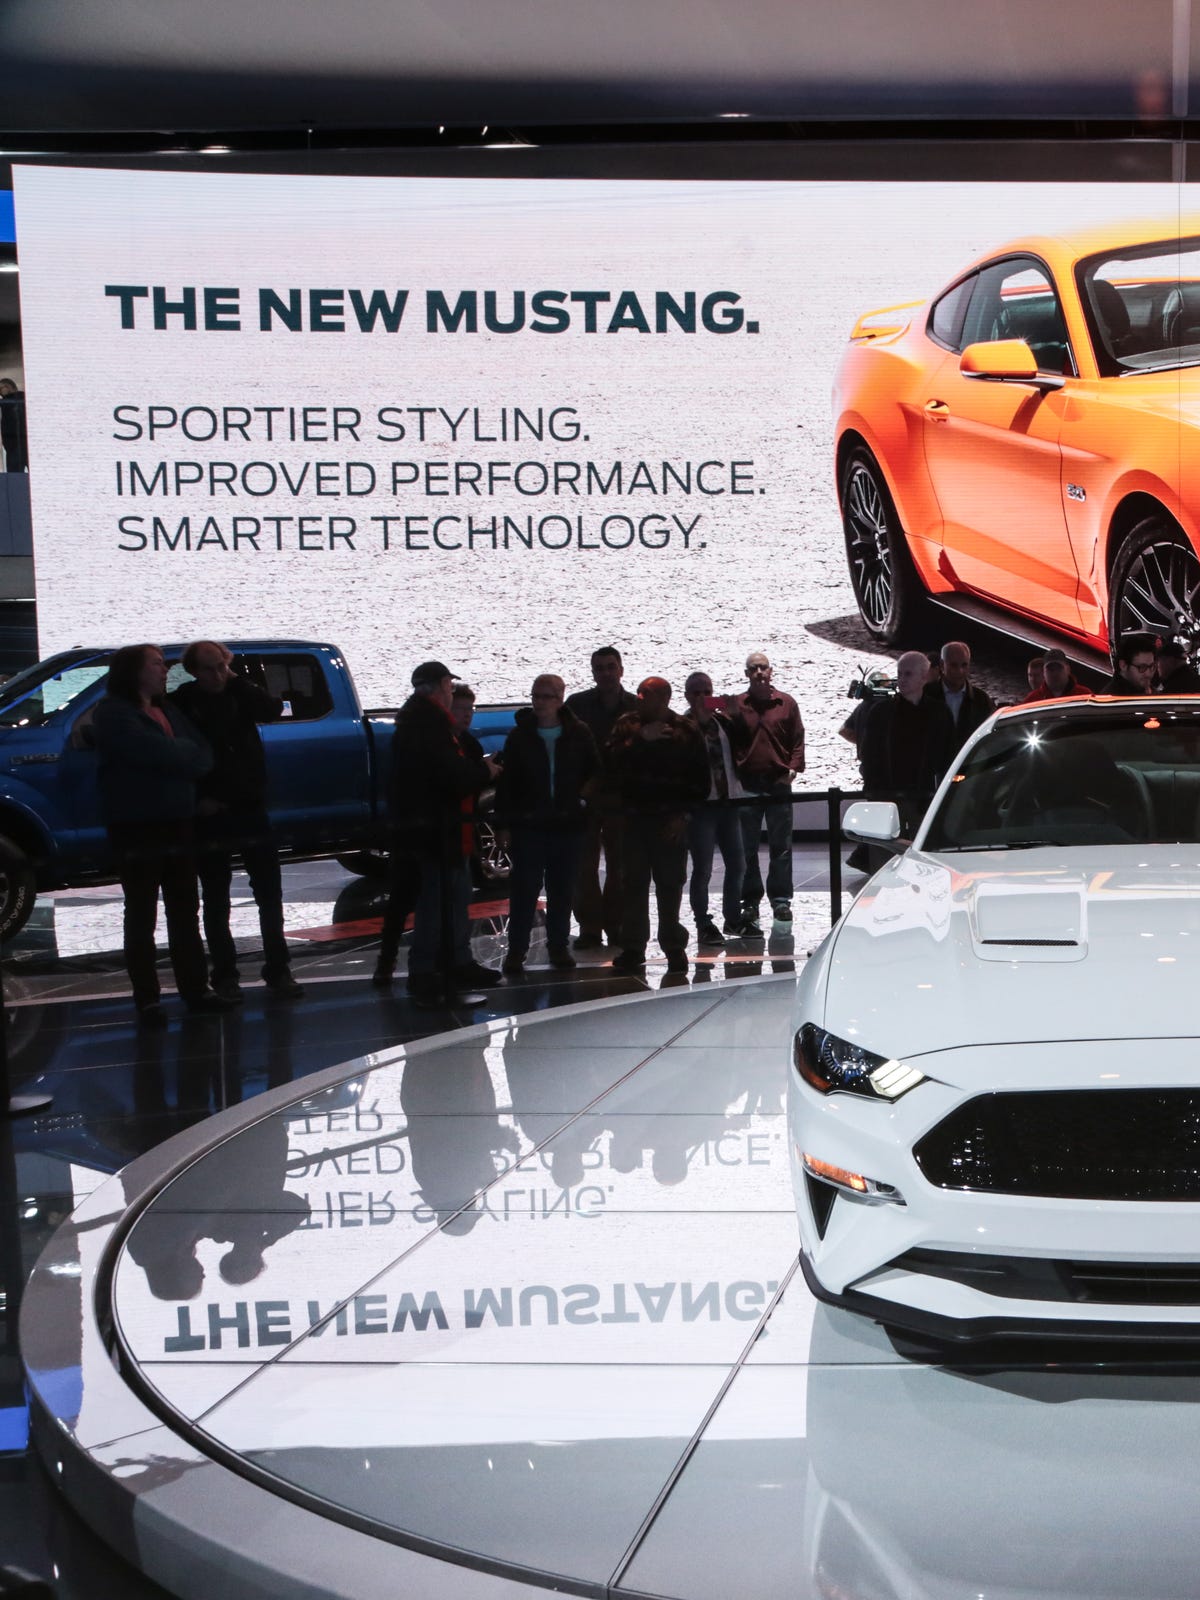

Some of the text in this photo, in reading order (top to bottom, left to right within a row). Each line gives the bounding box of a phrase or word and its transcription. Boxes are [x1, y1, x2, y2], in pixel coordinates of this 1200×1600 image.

[104, 285, 760, 334] THE NEW MUSTANG.
[112, 405, 591, 442] SPORTIER STYLING.
[116, 460, 766, 497] IMPROVED PERFORMANCE.
[118, 514, 708, 552] SMARTER TECHNOLOGY.
